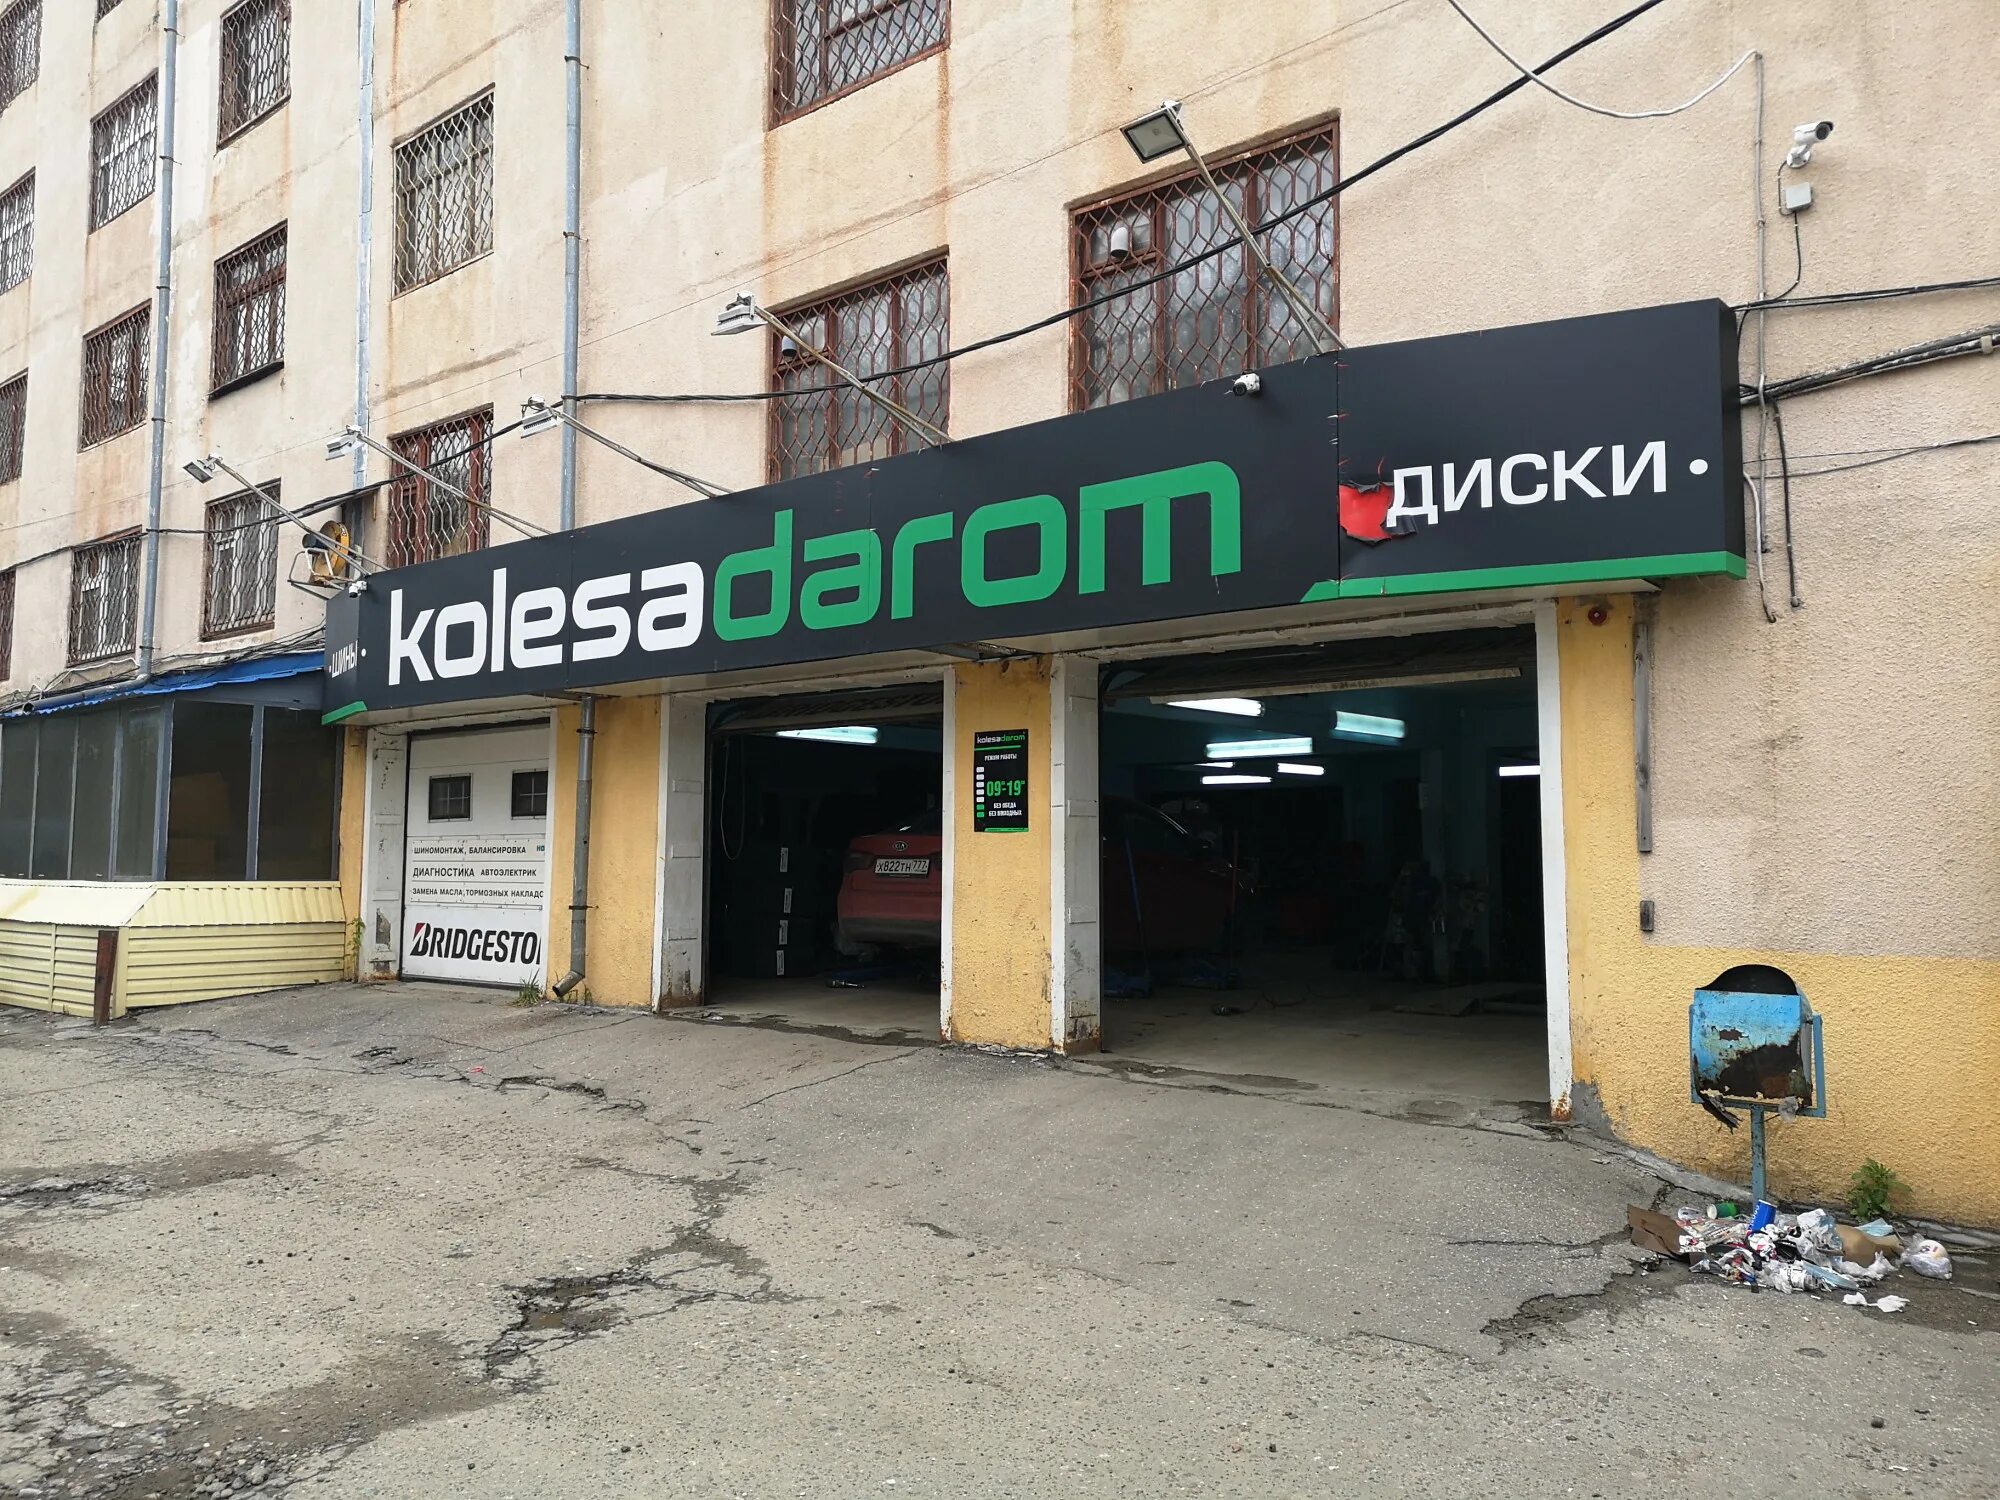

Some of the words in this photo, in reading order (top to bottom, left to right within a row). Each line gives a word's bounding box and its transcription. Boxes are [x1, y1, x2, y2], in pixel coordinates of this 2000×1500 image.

[1386, 440, 1667, 528] ДИСКИ
[386, 460, 1242, 686] kolesadarom
[469, 846, 527, 854] БАЛАНСИРОВКА
[412, 867, 475, 878] ДИАГНОСТИКА
[480, 868, 537, 877] АВТОЭЛЕКТРИК
[412, 887, 438, 895] ЗАМЕНА
[410, 922, 542, 965] BRIDGESTO
